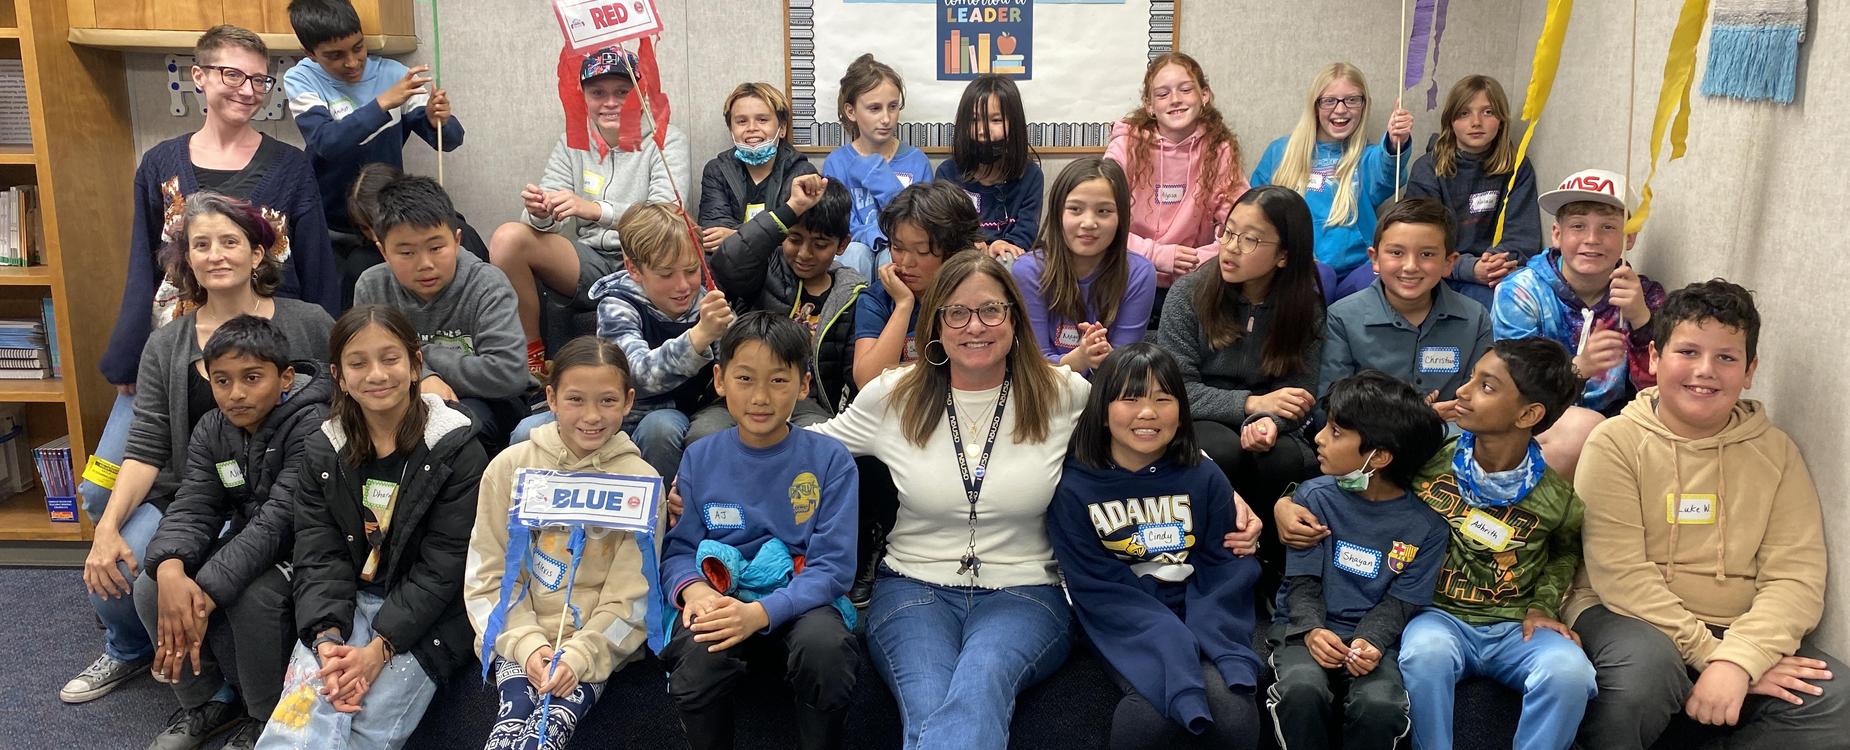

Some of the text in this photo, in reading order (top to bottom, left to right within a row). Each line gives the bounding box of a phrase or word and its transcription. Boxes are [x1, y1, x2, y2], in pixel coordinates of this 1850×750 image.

[589, 2, 629, 30] RED
[946, 7, 1022, 23] LEADER
[1559, 175, 1615, 196] NASA
[552, 488, 624, 512] BLUE
[1418, 473, 1540, 540] SR
[714, 510, 727, 520] AJ
[1087, 493, 1194, 539] ADAMS
[1148, 530, 1173, 544] Cindy
[1342, 551, 1373, 567] Shayan
